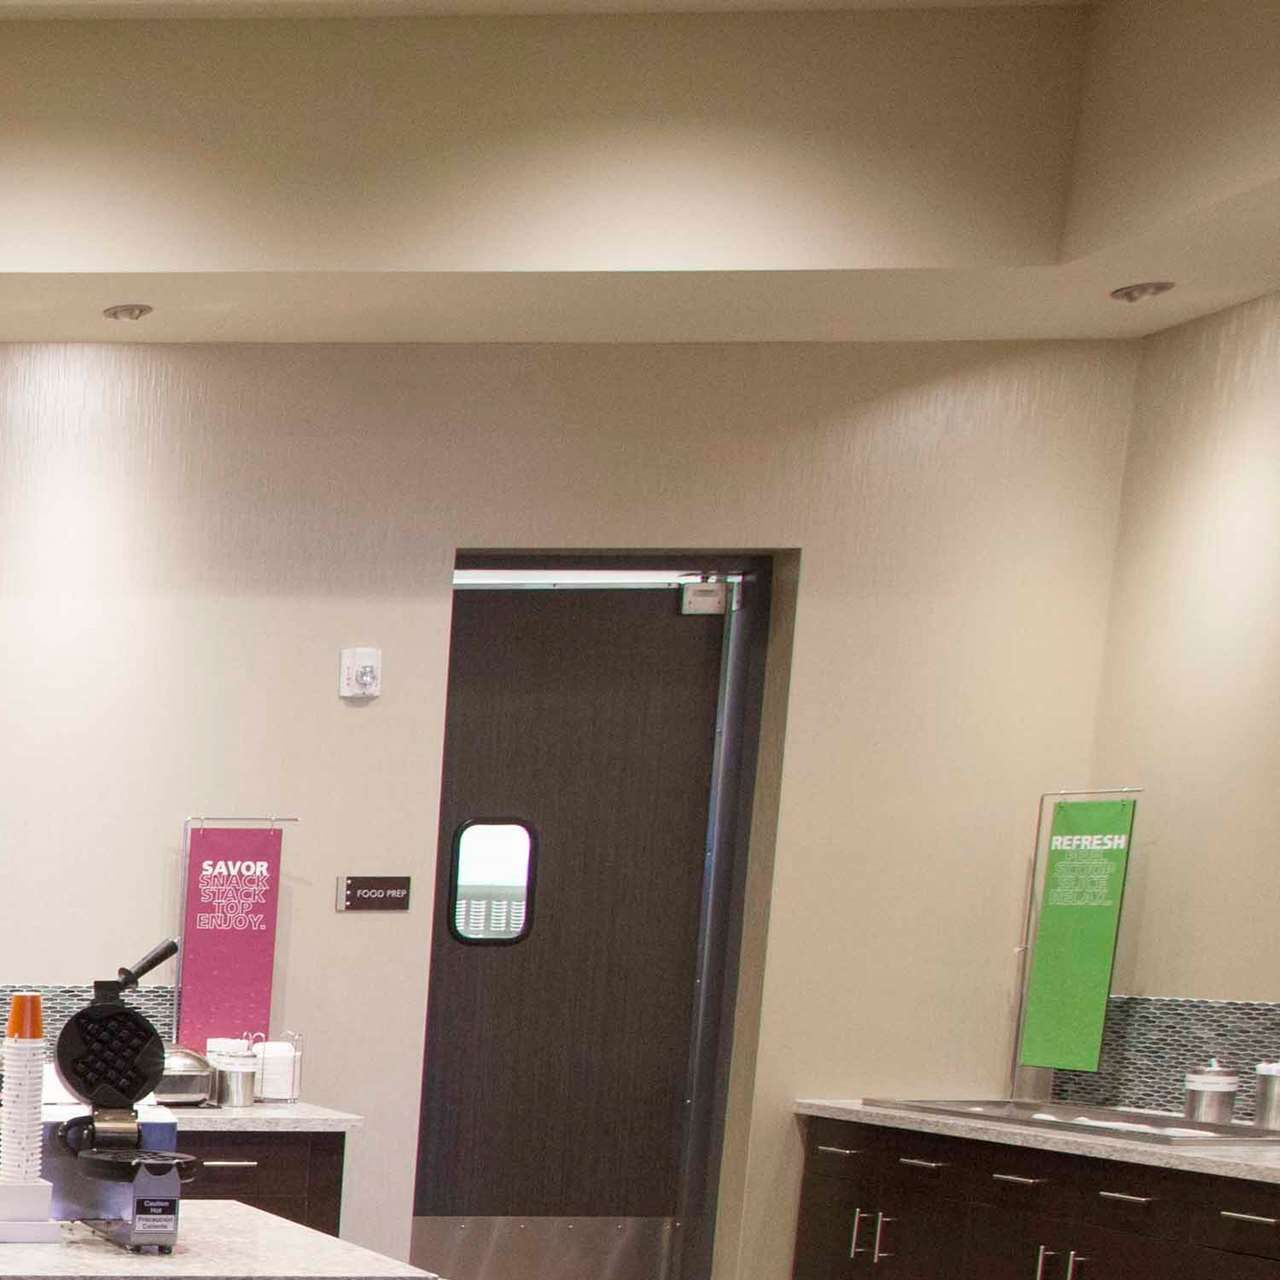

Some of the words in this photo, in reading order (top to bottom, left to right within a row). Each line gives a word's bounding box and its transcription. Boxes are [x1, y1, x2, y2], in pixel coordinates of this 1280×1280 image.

[1051, 835, 1126, 850] REFRESH
[202, 861, 269, 876] SAVOR
[198, 874, 271, 890] SNACK
[200, 887, 267, 904] STACK
[357, 889, 385, 898] FOOD
[386, 889, 407, 898] PREP
[212, 899, 254, 916] TOP
[196, 913, 267, 930] ENJOY.
